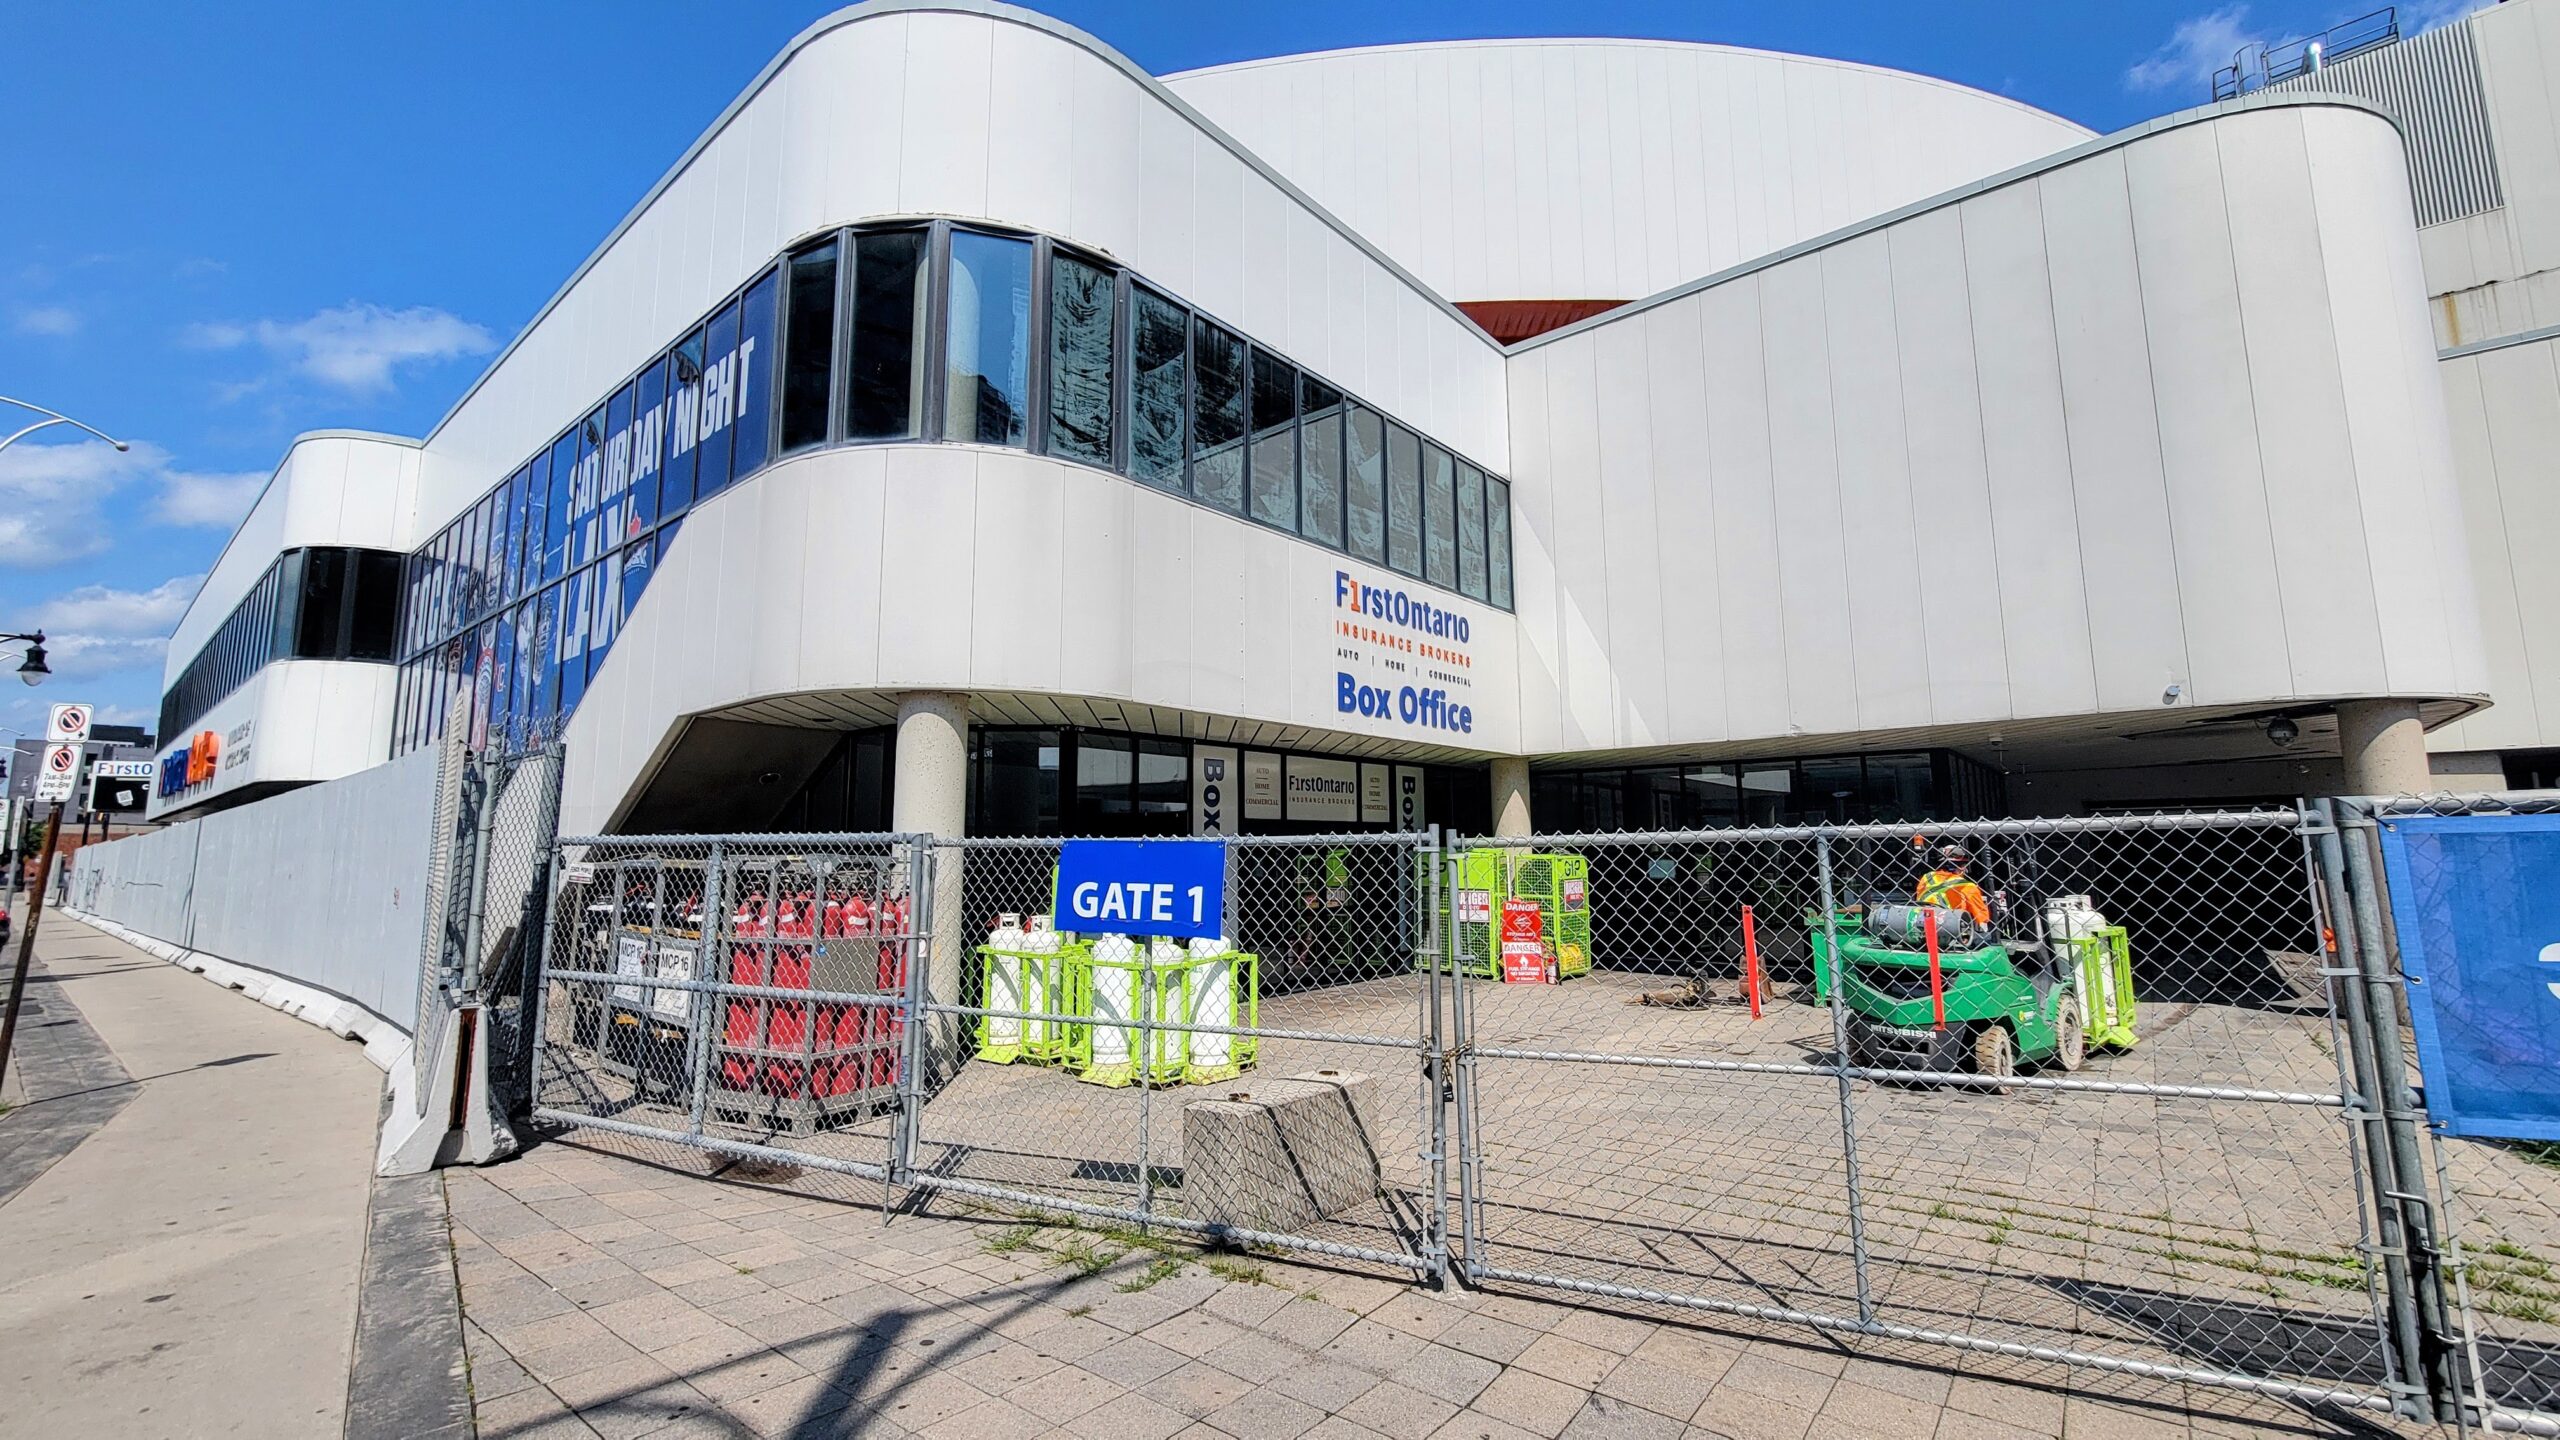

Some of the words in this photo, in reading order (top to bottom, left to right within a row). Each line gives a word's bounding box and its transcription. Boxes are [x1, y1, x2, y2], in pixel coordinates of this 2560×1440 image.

[566, 395, 674, 526] SATURDAY
[672, 335, 756, 460] NIGHT
[553, 494, 636, 666] LAX
[1336, 619, 1413, 654] INSURANCE
[1419, 643, 1472, 669] BROKERS
[1337, 647, 1360, 661] AUTO
[1385, 659, 1406, 673] HOME
[1428, 669, 1472, 688] COMMERCIAL
[1337, 671, 1392, 720] Box
[1399, 685, 1473, 734] Office
[1254, 782, 1271, 790] HOME
[1245, 798, 1279, 806] COMMERCIAL
[1288, 796, 1325, 804] INSURANCE
[1327, 797, 1355, 805] BROKERS
[1072, 881, 1174, 922] GATE
[1187, 886, 1203, 923] 1
[1505, 902, 1539, 912] DANGER
[621, 941, 636, 957] MCP
[1504, 944, 1541, 952] DANGER
[661, 952, 679, 970] MCP
[680, 955, 689, 972] 16
